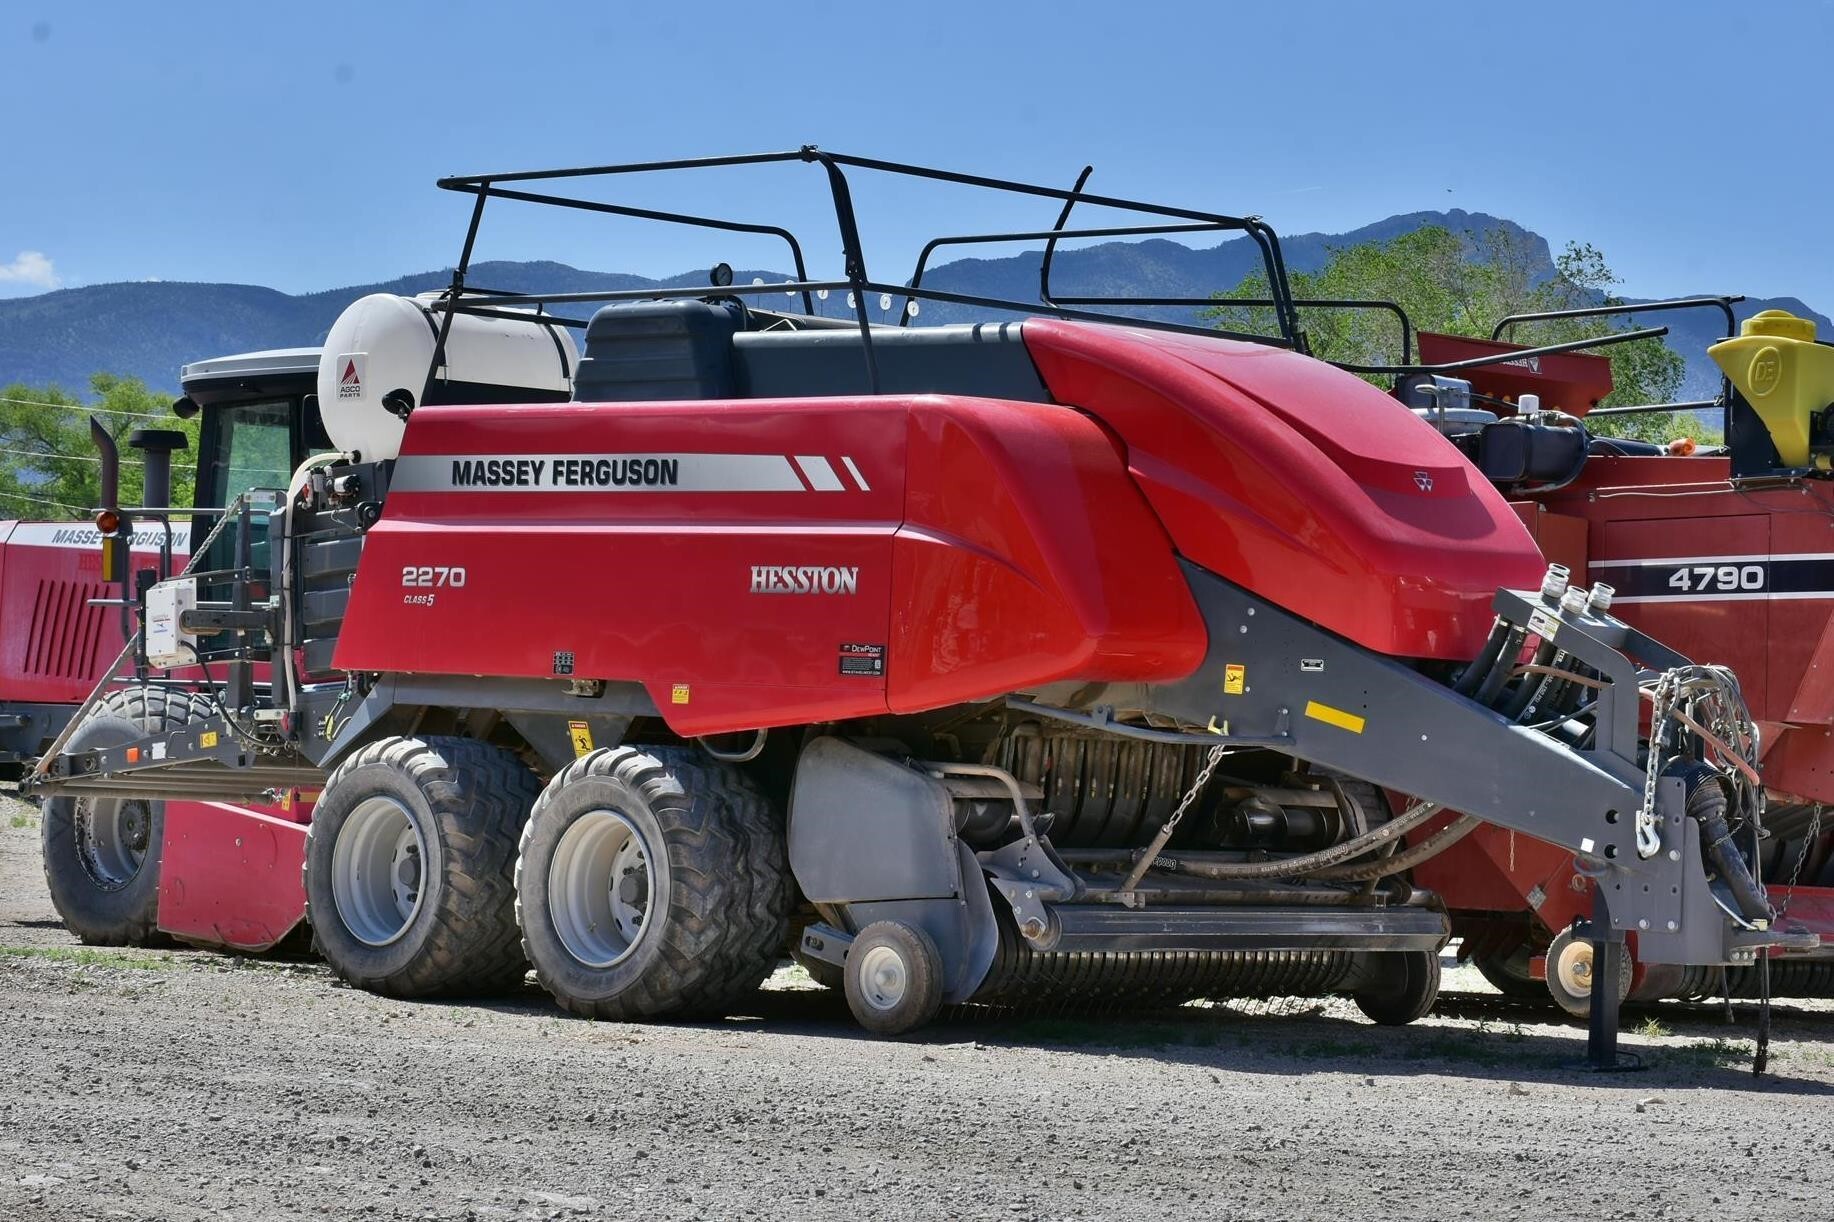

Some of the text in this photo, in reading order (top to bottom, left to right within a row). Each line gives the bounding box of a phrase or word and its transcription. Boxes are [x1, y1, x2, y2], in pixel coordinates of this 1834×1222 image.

[451, 458, 679, 487] MASSEY FERGUSON
[124, 531, 188, 548] RGUSN
[402, 566, 467, 588] 2270
[750, 565, 859, 595] HESSTON
[1668, 564, 1765, 592] 4790
